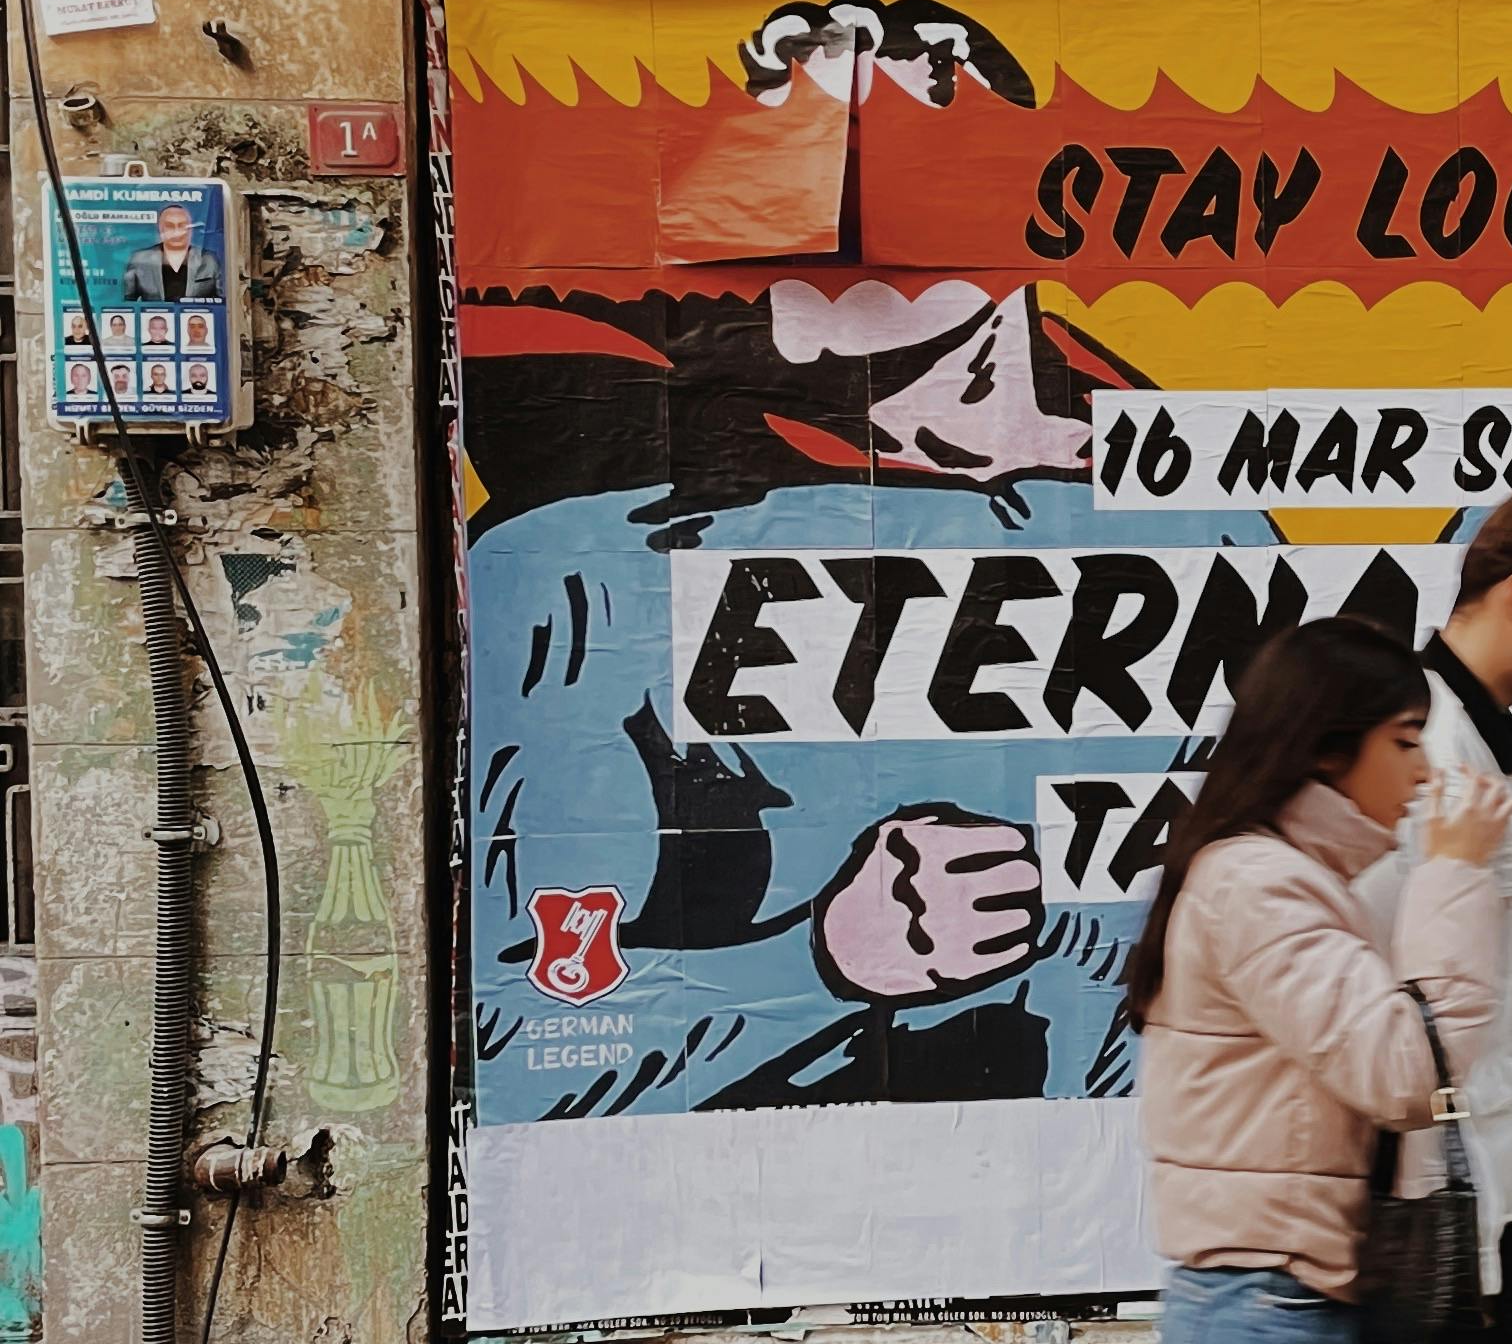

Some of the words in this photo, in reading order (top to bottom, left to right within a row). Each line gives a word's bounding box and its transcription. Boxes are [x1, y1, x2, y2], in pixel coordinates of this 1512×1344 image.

[113, 190, 203, 202] KUMBASAR
[1024, 143, 1322, 260] STAY
[1100, 405, 1193, 497] 16
[1216, 406, 1429, 497] MAR
[526, 1014, 634, 1041] GERMAN
[527, 1044, 634, 1071] LEGEND
